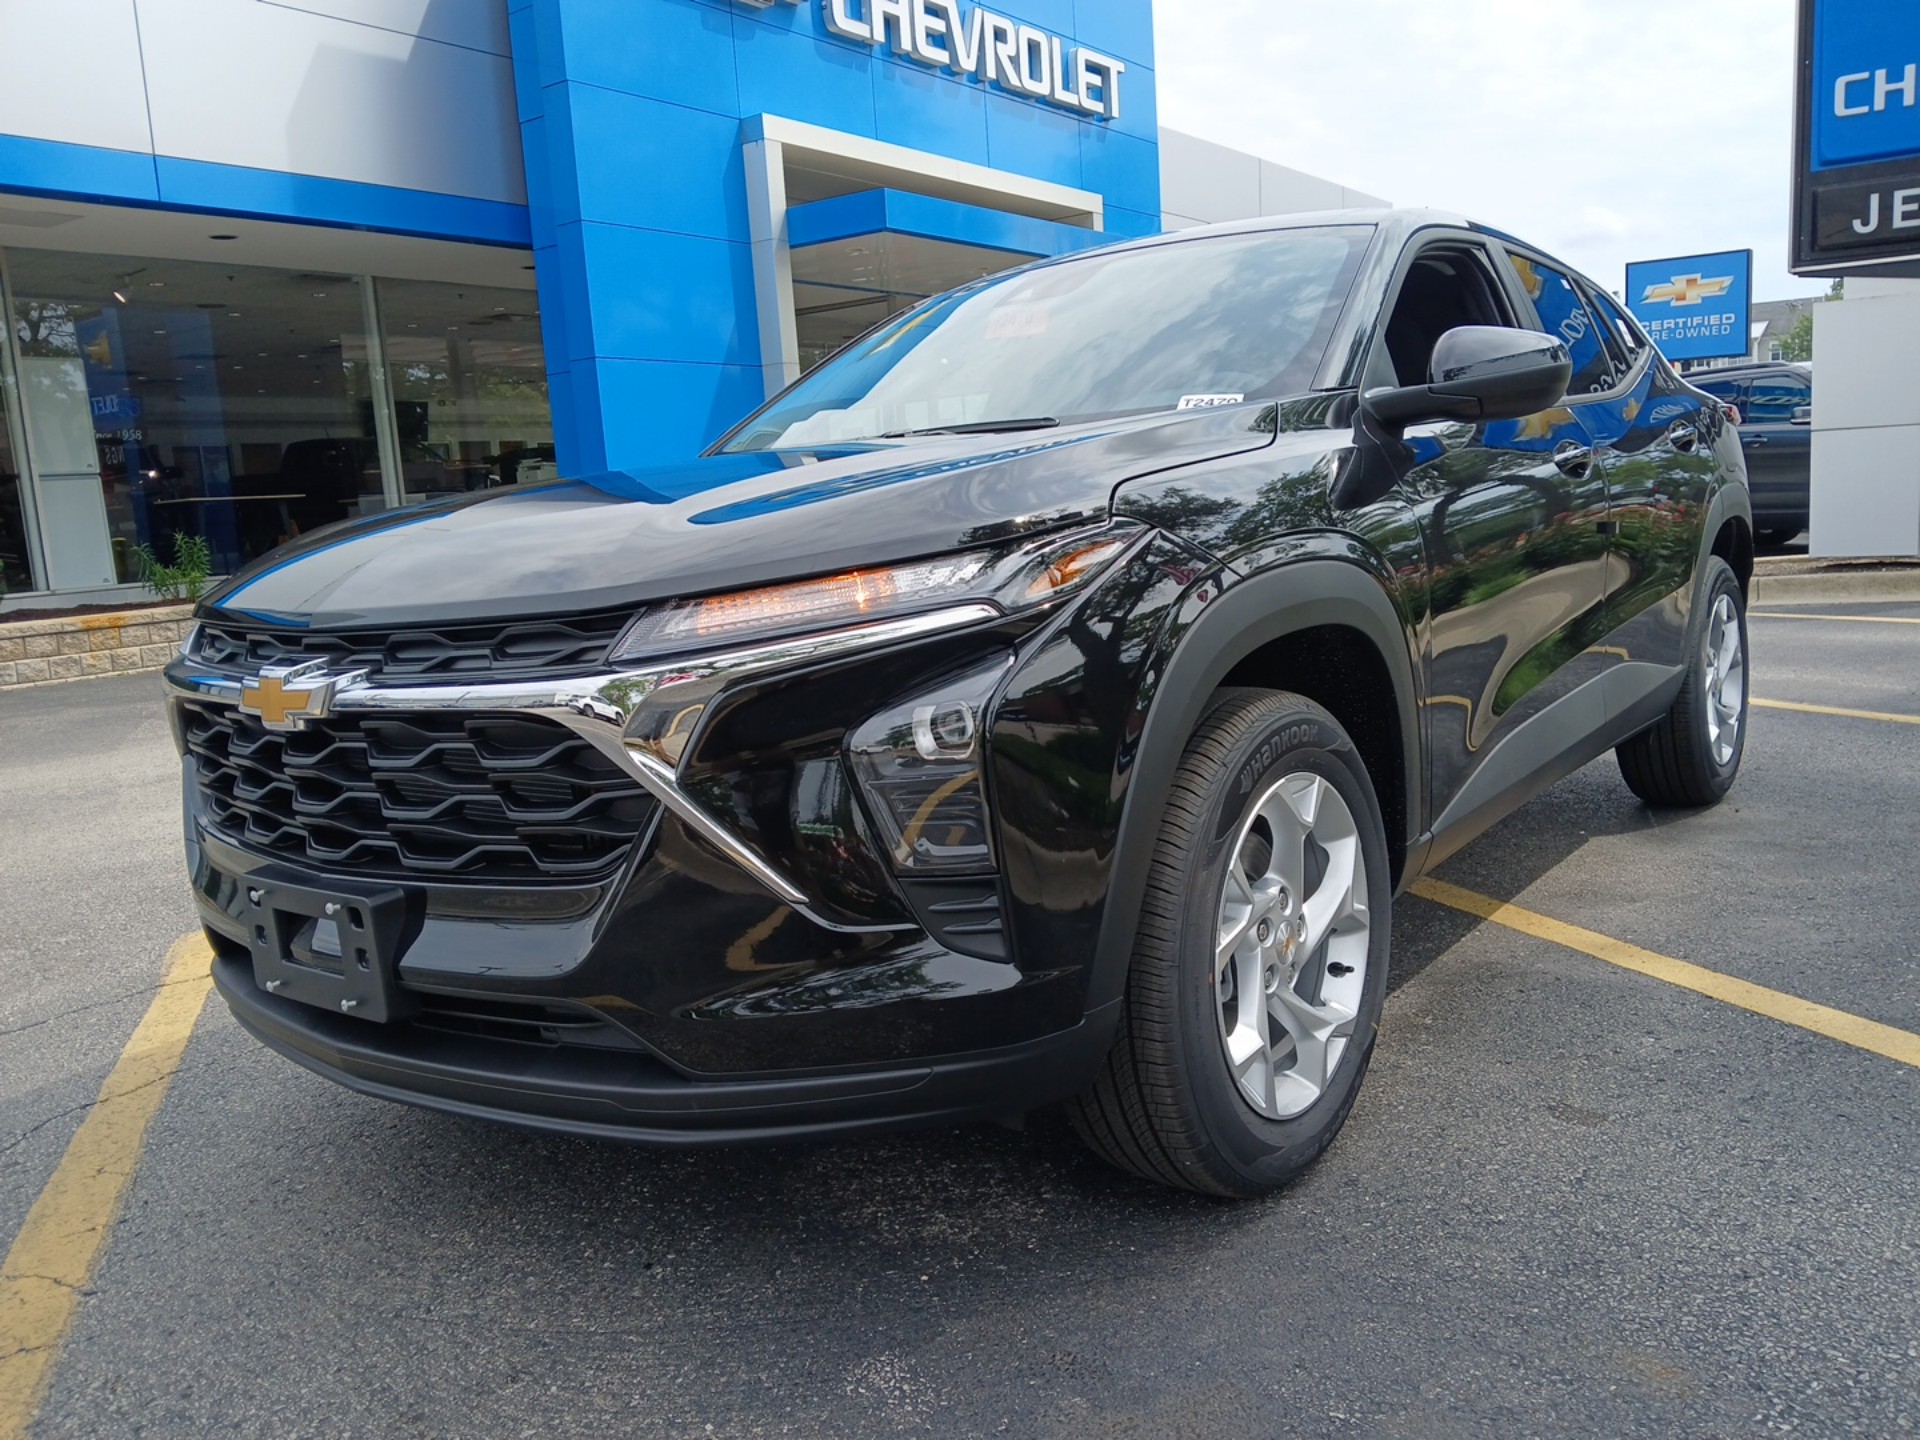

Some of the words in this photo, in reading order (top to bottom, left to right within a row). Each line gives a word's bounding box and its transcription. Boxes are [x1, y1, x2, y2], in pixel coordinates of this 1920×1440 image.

[1834, 63, 1917, 117] CH
[1852, 187, 1920, 234] JE
[1640, 313, 1736, 331] CERTIFIED
[1651, 324, 1731, 341] RE-OWNED
